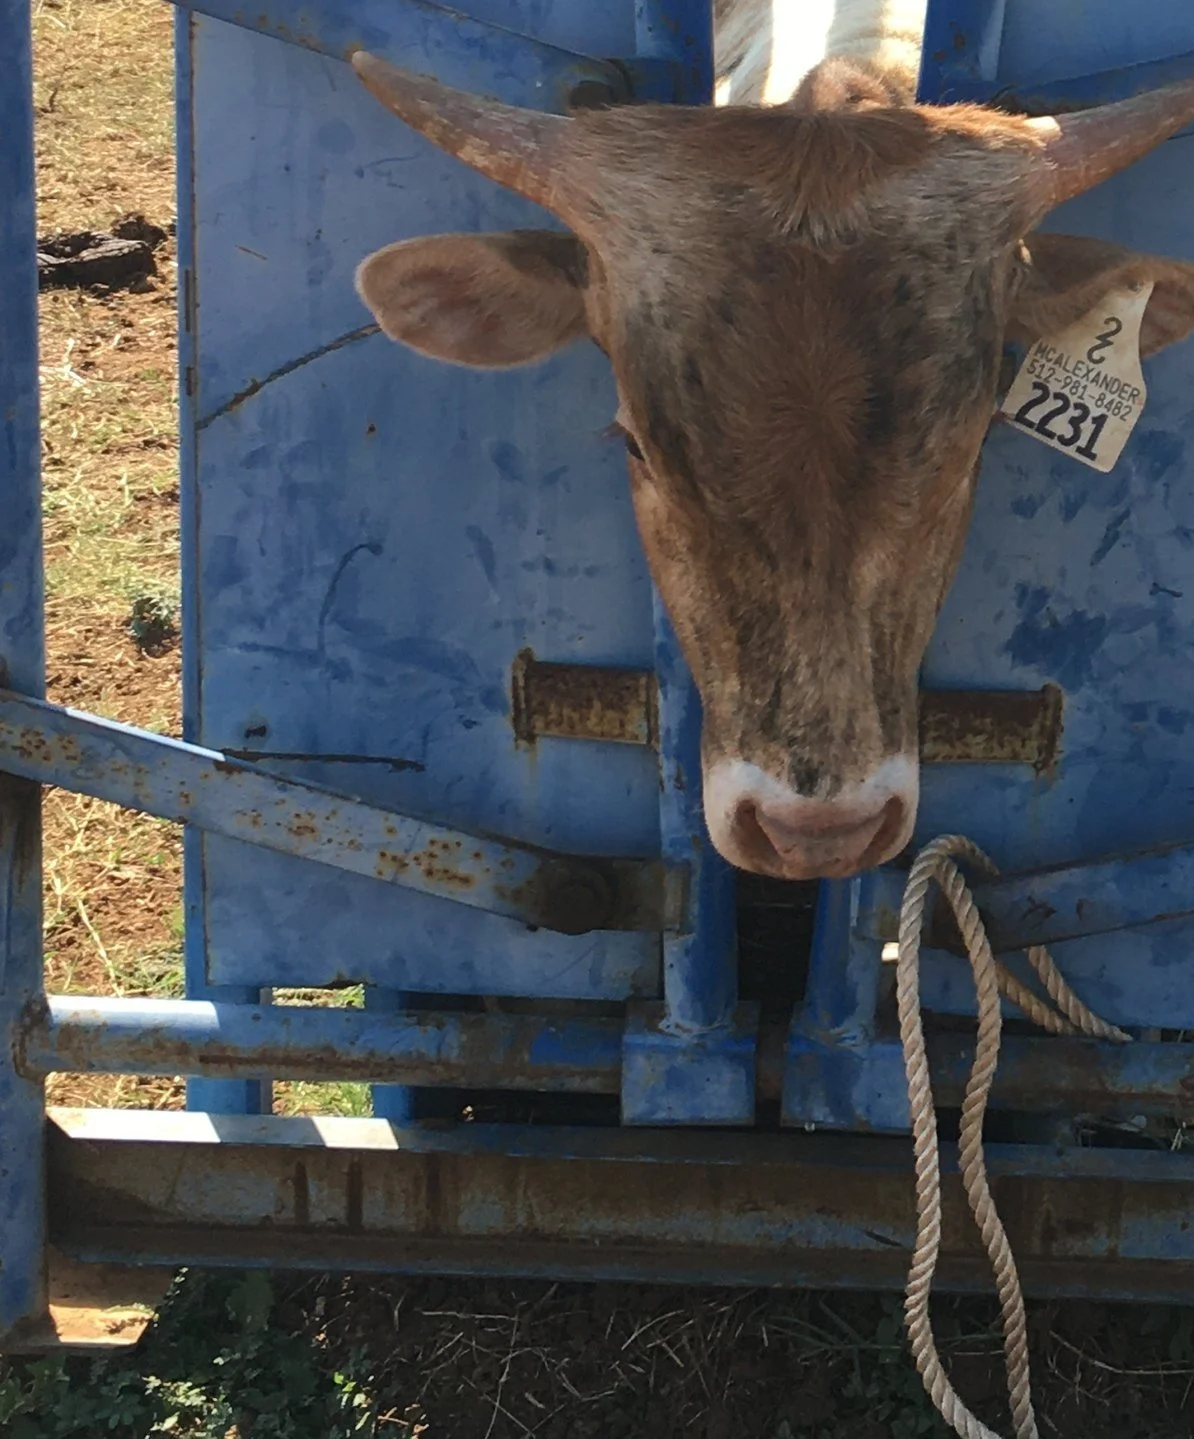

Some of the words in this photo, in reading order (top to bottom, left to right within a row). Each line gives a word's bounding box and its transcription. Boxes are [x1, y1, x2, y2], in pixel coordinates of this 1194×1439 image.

[1026, 359, 1133, 422] 512-981-8482
[1034, 341, 1141, 404] MCALEXANDER
[1014, 380, 1109, 461] 2231
